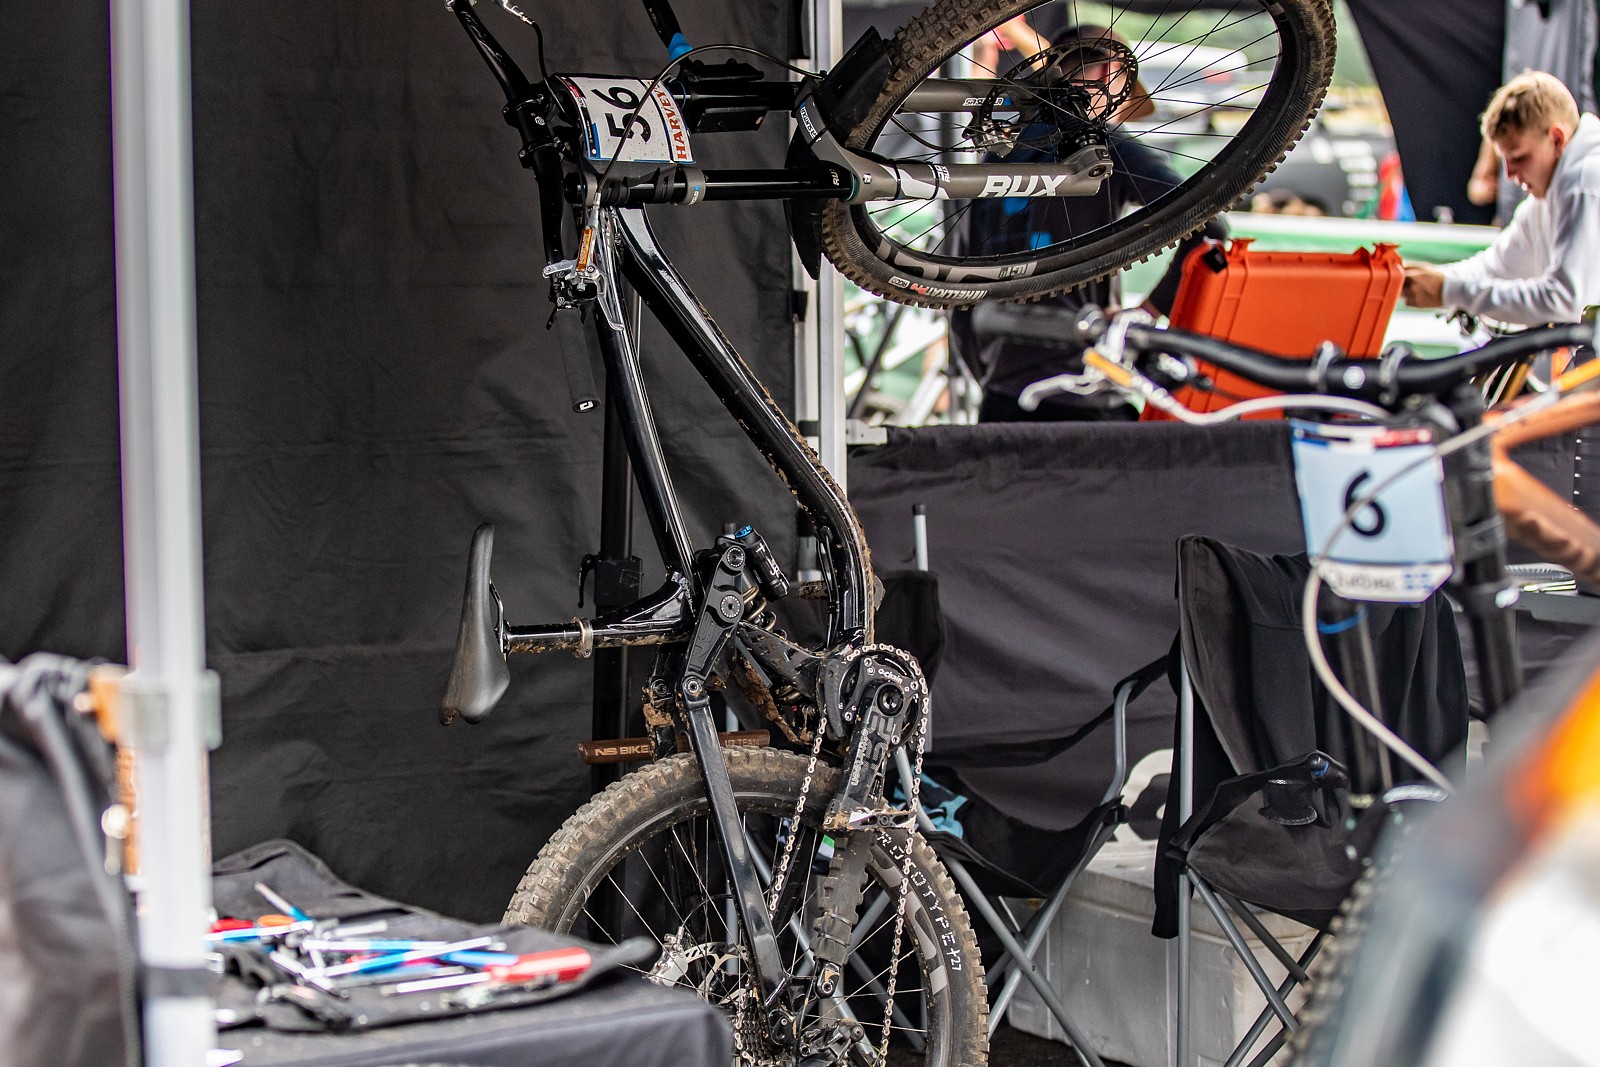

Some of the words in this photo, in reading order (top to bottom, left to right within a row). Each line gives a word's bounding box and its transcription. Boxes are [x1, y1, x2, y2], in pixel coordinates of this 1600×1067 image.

[591, 87, 651, 143] 56
[977, 175, 1068, 197] RUX
[1344, 470, 1386, 537] 6
[594, 746, 618, 757] NS
